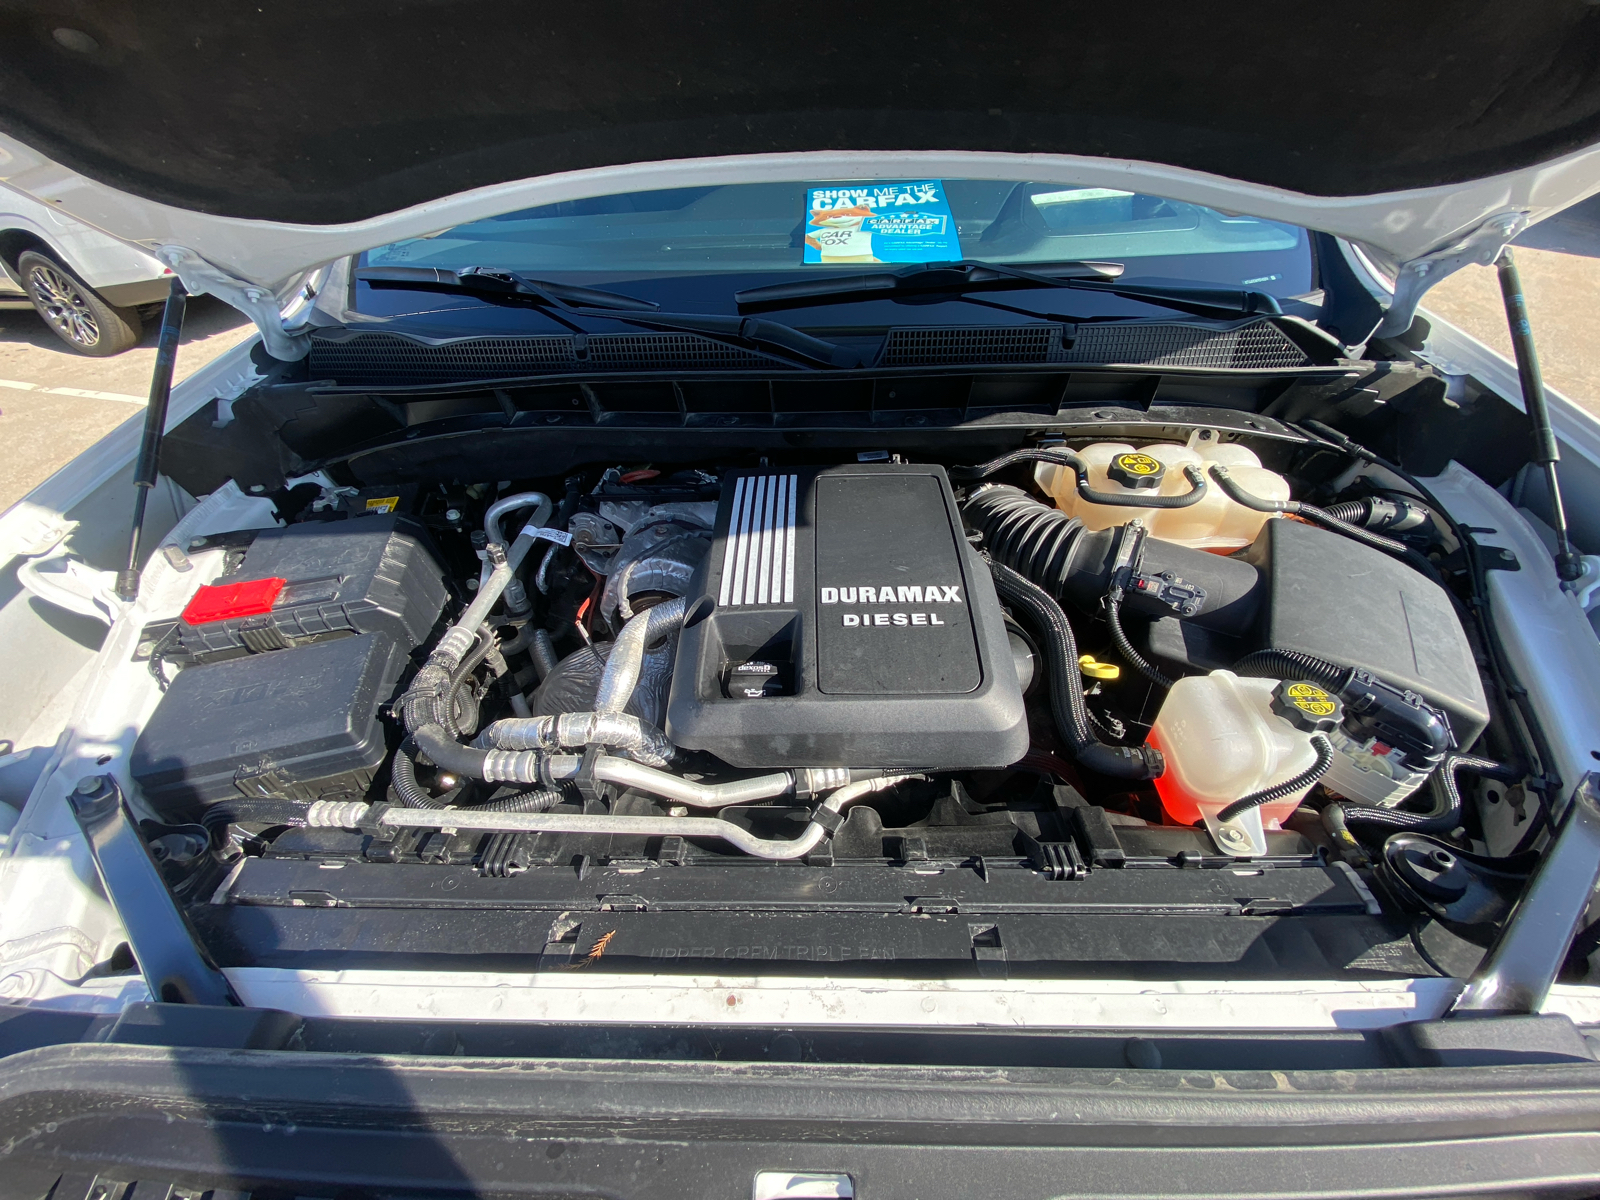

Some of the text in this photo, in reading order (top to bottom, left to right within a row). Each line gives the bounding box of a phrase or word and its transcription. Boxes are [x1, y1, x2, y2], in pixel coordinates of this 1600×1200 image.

[812, 183, 936, 199] SHOW ME THE
[812, 190, 940, 211] CARFAX
[821, 230, 853, 239] CAR
[820, 585, 963, 604] DURAMAX
[842, 613, 945, 628] DIESEL
